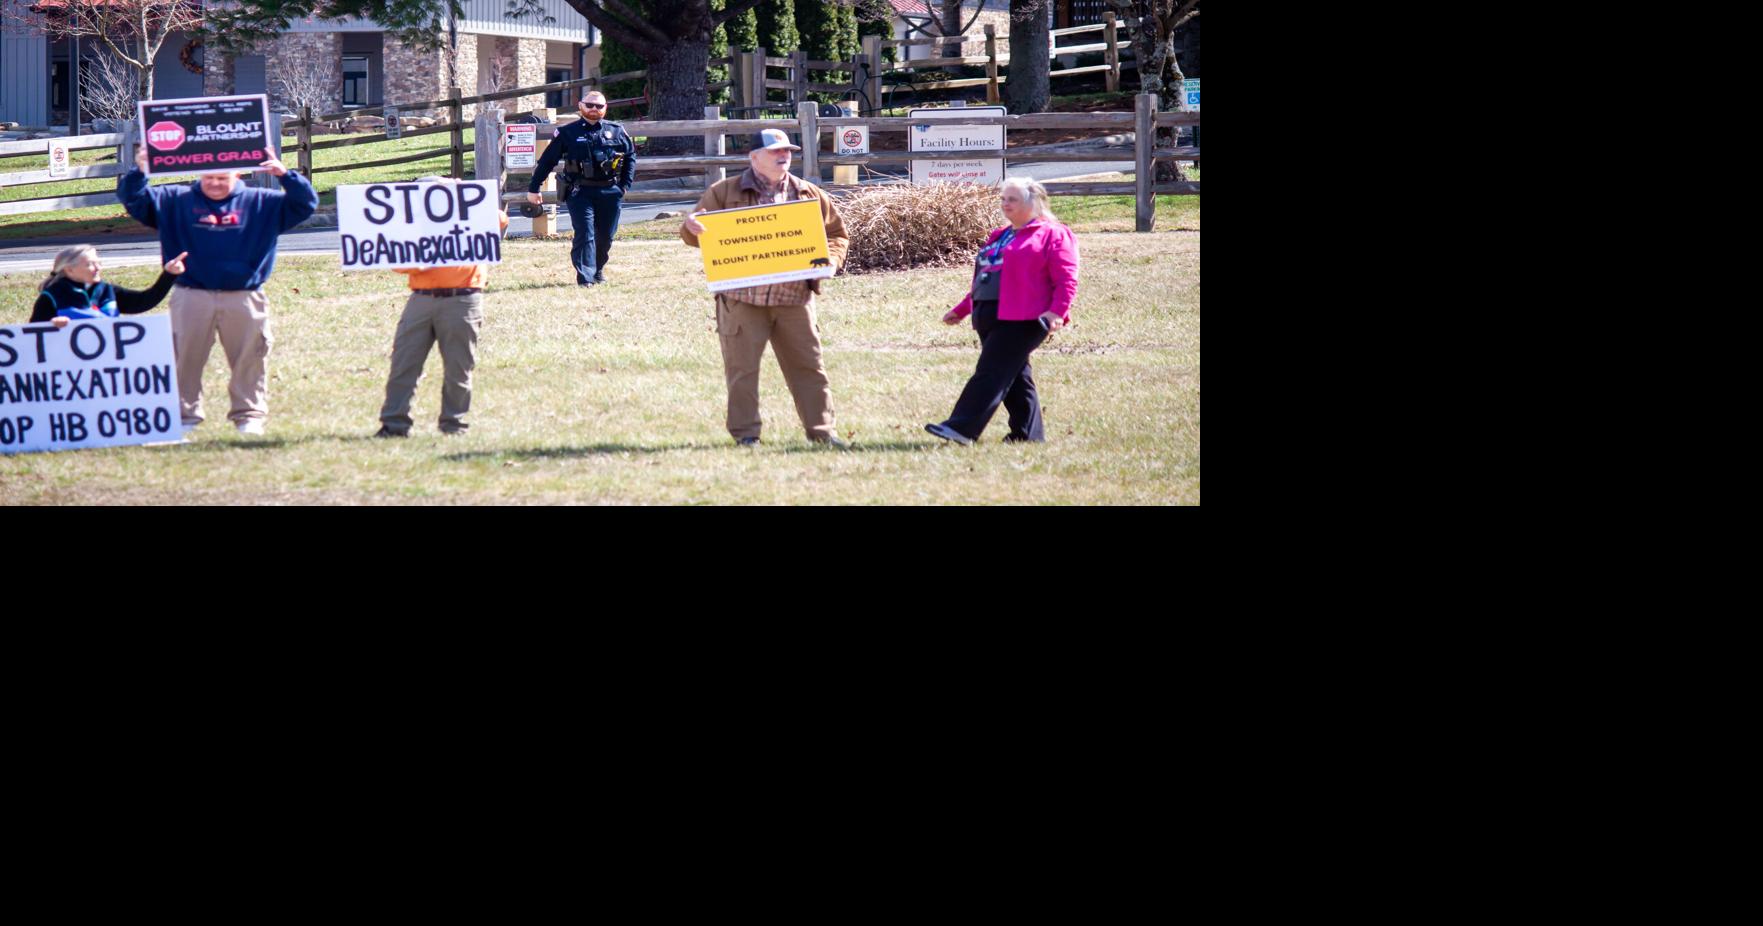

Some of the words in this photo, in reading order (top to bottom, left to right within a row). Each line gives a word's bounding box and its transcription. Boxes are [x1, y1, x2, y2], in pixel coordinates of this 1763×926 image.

[150, 130, 181, 142] STOP
[196, 122, 262, 134] BLOUNT
[187, 131, 262, 142] PARTNERSHIP
[920, 138, 956, 148] Facility
[959, 137, 995, 147] Hours:
[153, 153, 214, 166] POWER
[217, 150, 263, 162] GRAB
[363, 183, 487, 225] STOP
[736, 213, 778, 225] PROTECT
[341, 224, 501, 266] DeAnnexation
[718, 234, 773, 246] TOWNSEND
[775, 229, 803, 239] FROM
[712, 255, 749, 266] BLOUNT
[752, 246, 816, 260] PARTNERSHIP
[0, 321, 146, 367] STOP
[49, 412, 88, 442] HB
[98, 407, 171, 439] 0980
